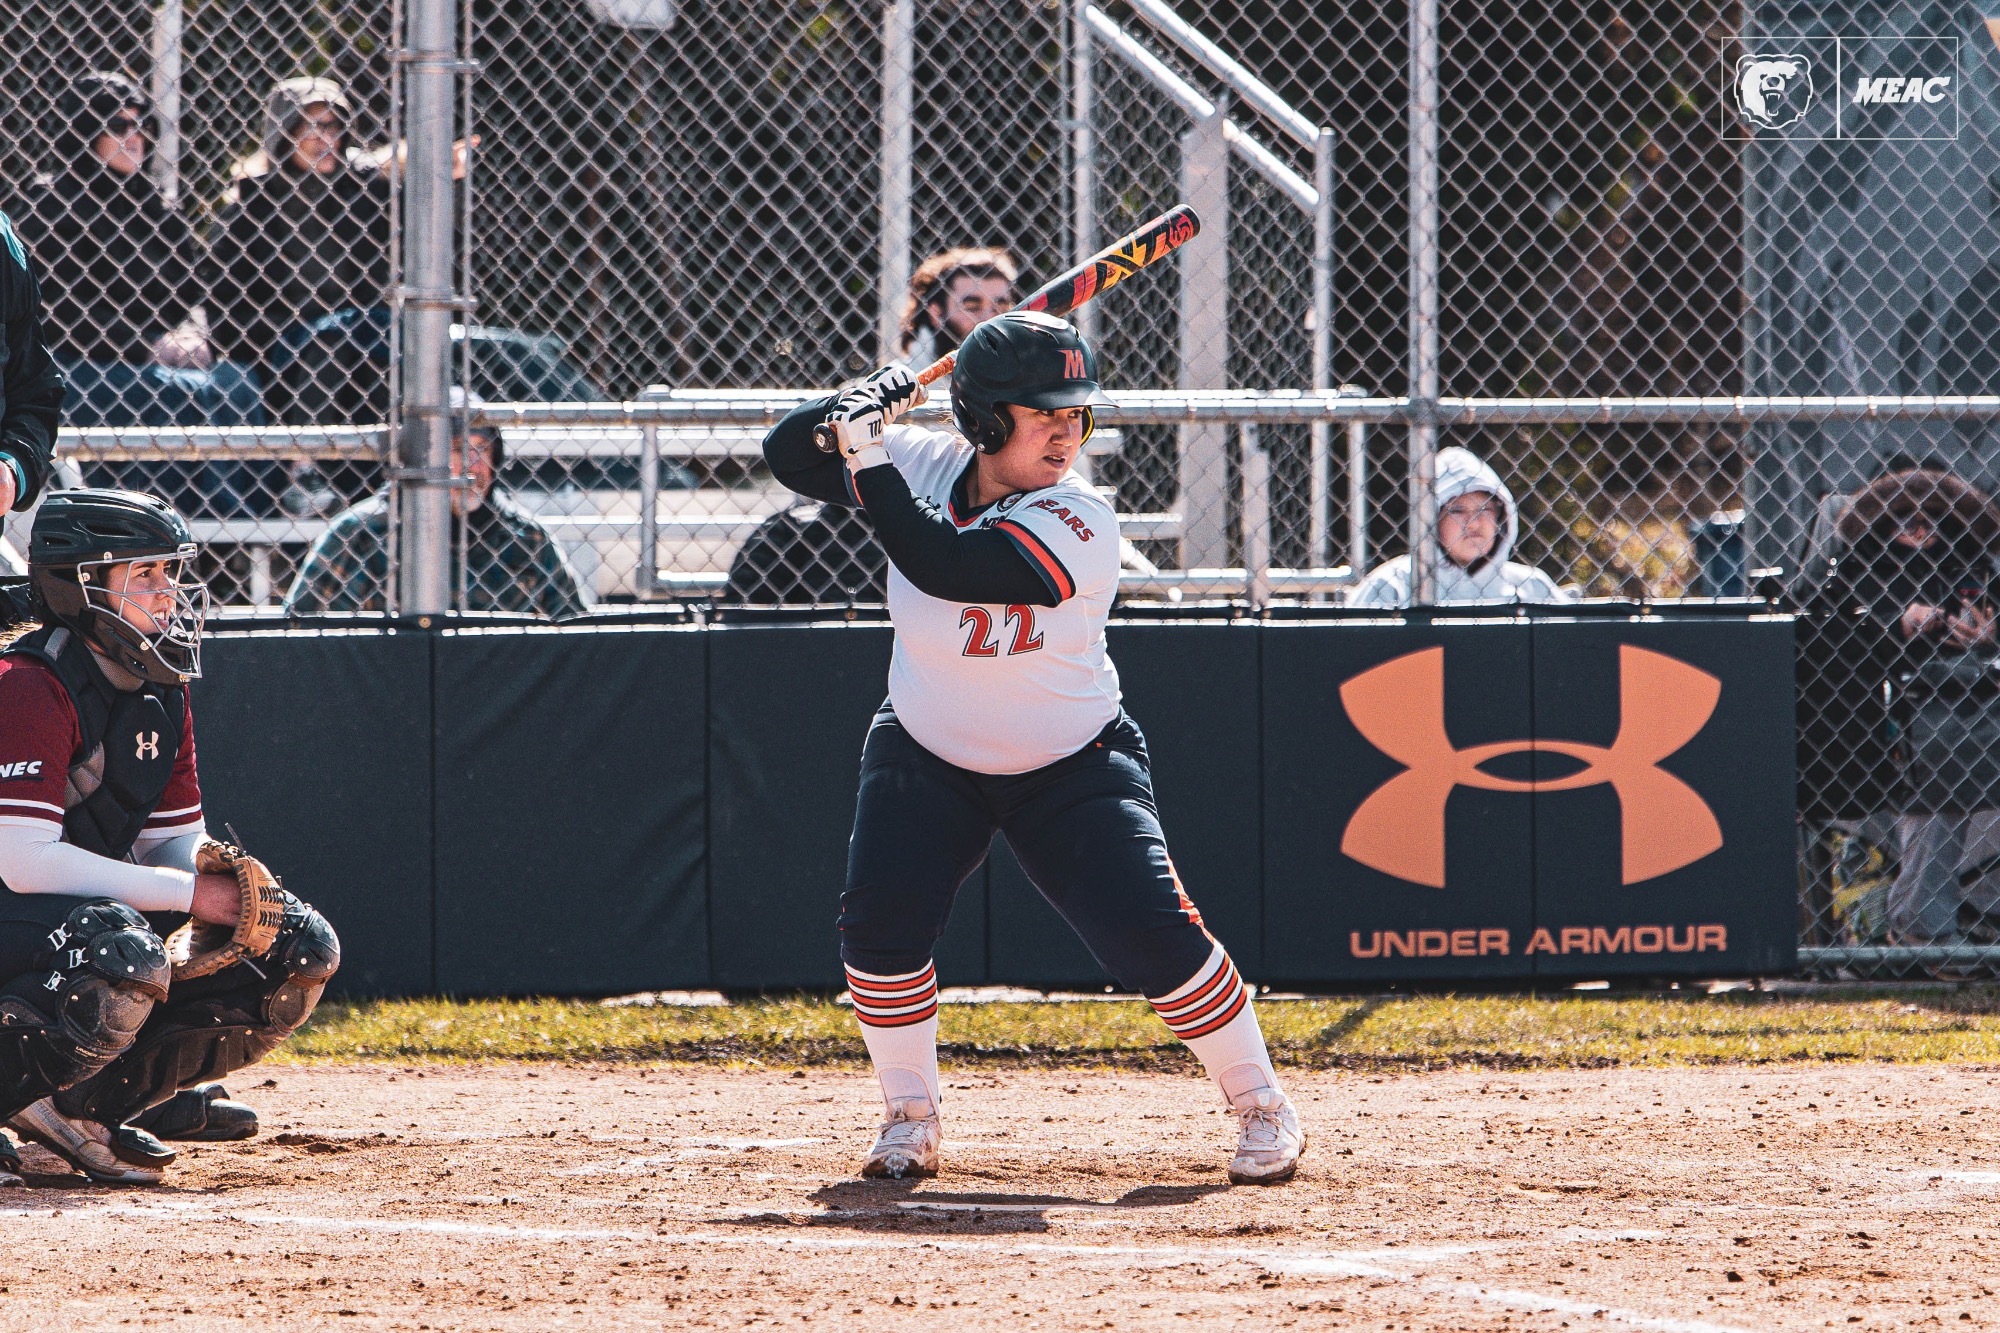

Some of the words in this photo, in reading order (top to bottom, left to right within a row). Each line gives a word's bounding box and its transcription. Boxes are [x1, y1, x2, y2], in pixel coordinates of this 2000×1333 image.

[1057, 349, 1087, 379] M
[959, 604, 1043, 657] 22
[0, 761, 43, 778] NEC
[1350, 929, 1510, 959] UNDER
[1524, 925, 1728, 955] ARMOUR
